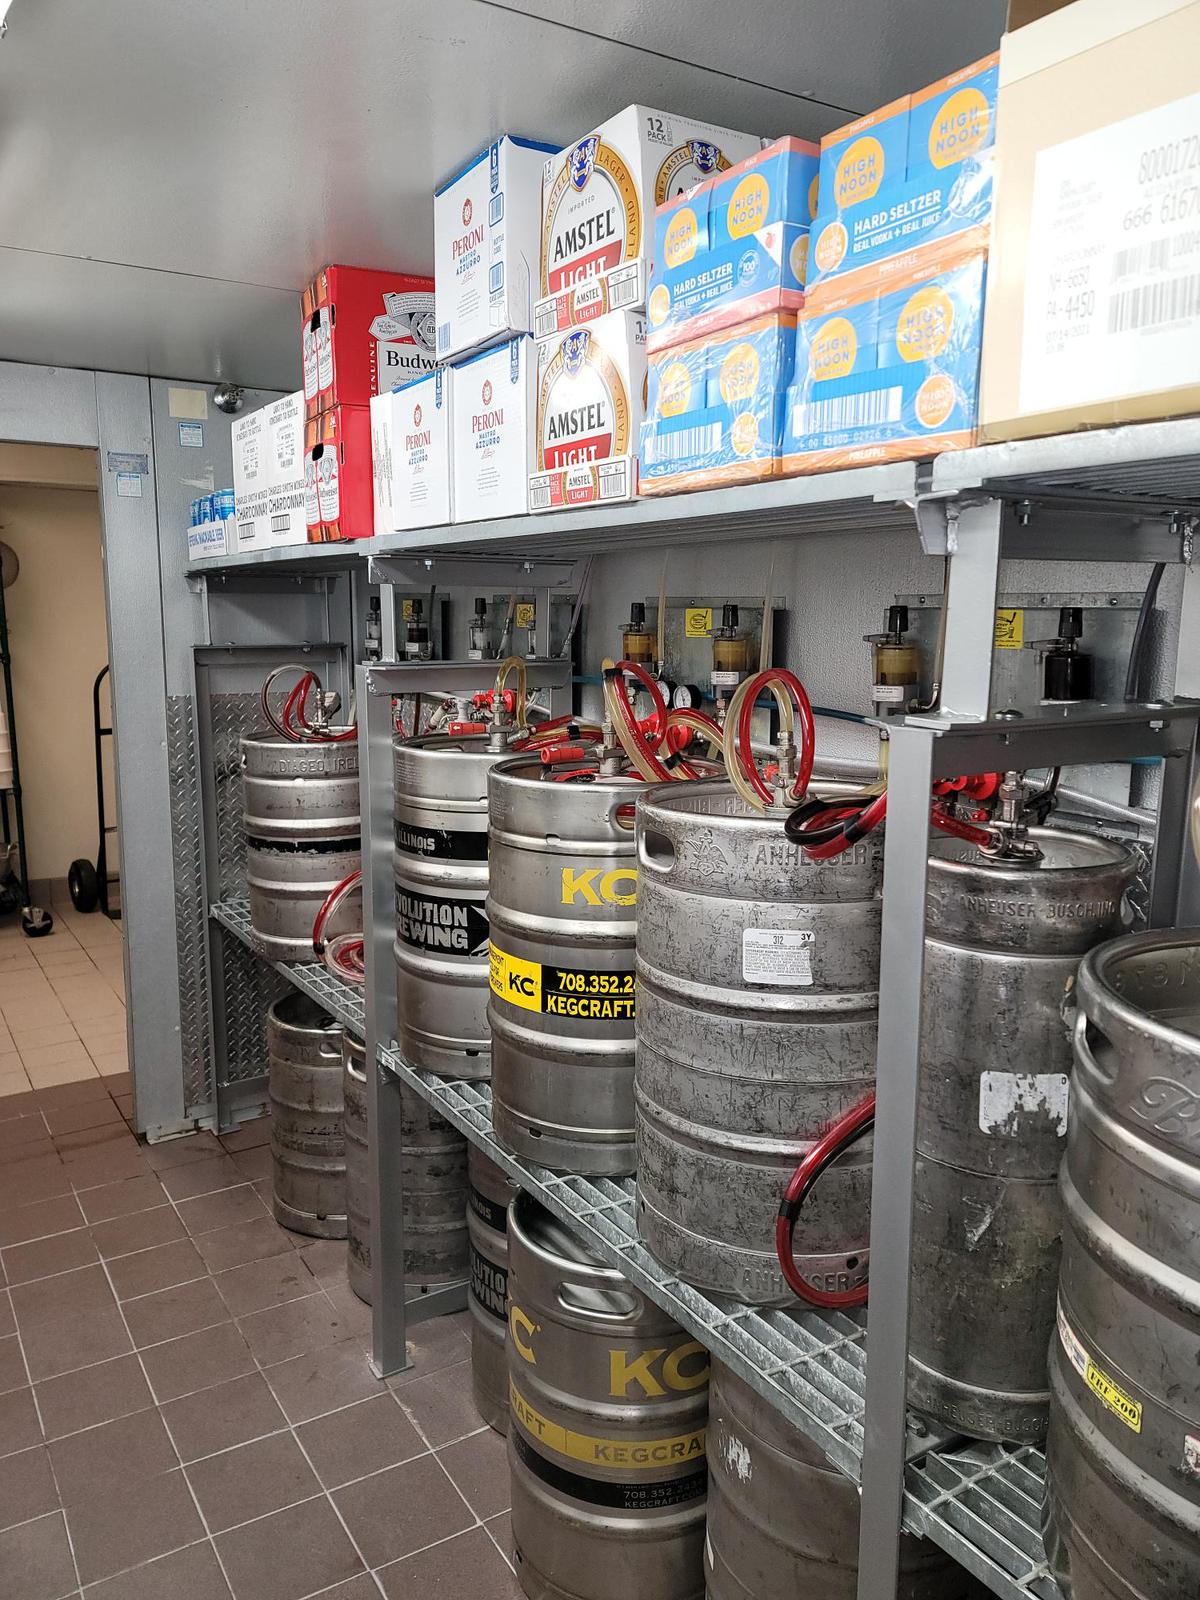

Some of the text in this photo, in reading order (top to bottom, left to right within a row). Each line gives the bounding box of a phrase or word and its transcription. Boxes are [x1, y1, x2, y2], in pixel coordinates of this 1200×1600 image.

[647, 117, 663, 132] 12
[940, 106, 978, 135] HIGH
[648, 131, 667, 142] PACK
[936, 125, 980, 153] NOON
[598, 153, 626, 182] LAGER
[663, 150, 688, 178] AMSTEL
[843, 153, 876, 177] HIGH
[1139, 135, 1200, 185] 8000172
[840, 170, 876, 196] NOON
[568, 194, 595, 215] IMPORTED
[735, 190, 762, 211] HIGH
[854, 189, 942, 235] HARD SELTZER
[732, 206, 762, 226] NOON
[1123, 204, 1152, 231] 666
[452, 224, 485, 260] PERONI
[553, 209, 615, 262] AMSTEL
[669, 224, 692, 241] HIGH
[853, 238, 870, 254] REAL
[871, 231, 894, 250] VODKA
[902, 221, 920, 235] REAL
[922, 212, 941, 230] JUICE
[459, 250, 477, 266] NASTRO
[669, 238, 693, 256] NOON
[456, 255, 481, 277] AZZURRO
[559, 256, 607, 290] LIGHT
[879, 253, 918, 275] PINEAPPLE
[673, 262, 733, 295] HARD SELTZER
[576, 287, 599, 306] AMSTEL
[707, 287, 721, 299] REAL
[906, 304, 944, 326] HIGH
[818, 335, 848, 356] HIGH
[386, 350, 448, 369] Budwe
[815, 351, 849, 368] NOON
[472, 408, 504, 434] PERONI
[548, 402, 605, 441] AMSTEL
[405, 430, 431, 452] PERONI
[475, 436, 501, 450] AZZURRO
[479, 430, 496, 440] NASTRO
[408, 454, 429, 466] AZZURRO
[553, 445, 598, 468] LIGHT
[848, 446, 887, 462] PINEAPPLE
[569, 474, 591, 487] AMSTEL
[237, 492, 305, 522] CHARDONNAY CHARDONNAY
[280, 757, 359, 773] DIAGEO IREL
[561, 868, 637, 906] KC
[959, 894, 1036, 918] ANHEUSER
[773, 935, 784, 945] 312
[801, 932, 812, 942] 3Y
[508, 971, 536, 997] KC
[558, 971, 636, 994] 708.352.2
[547, 994, 636, 1018] KEGCRAFT.
[608, 1342, 710, 1397] KC
[1113, 1395, 1137, 1419] 200
[593, 1430, 707, 1464] KEGCRA
